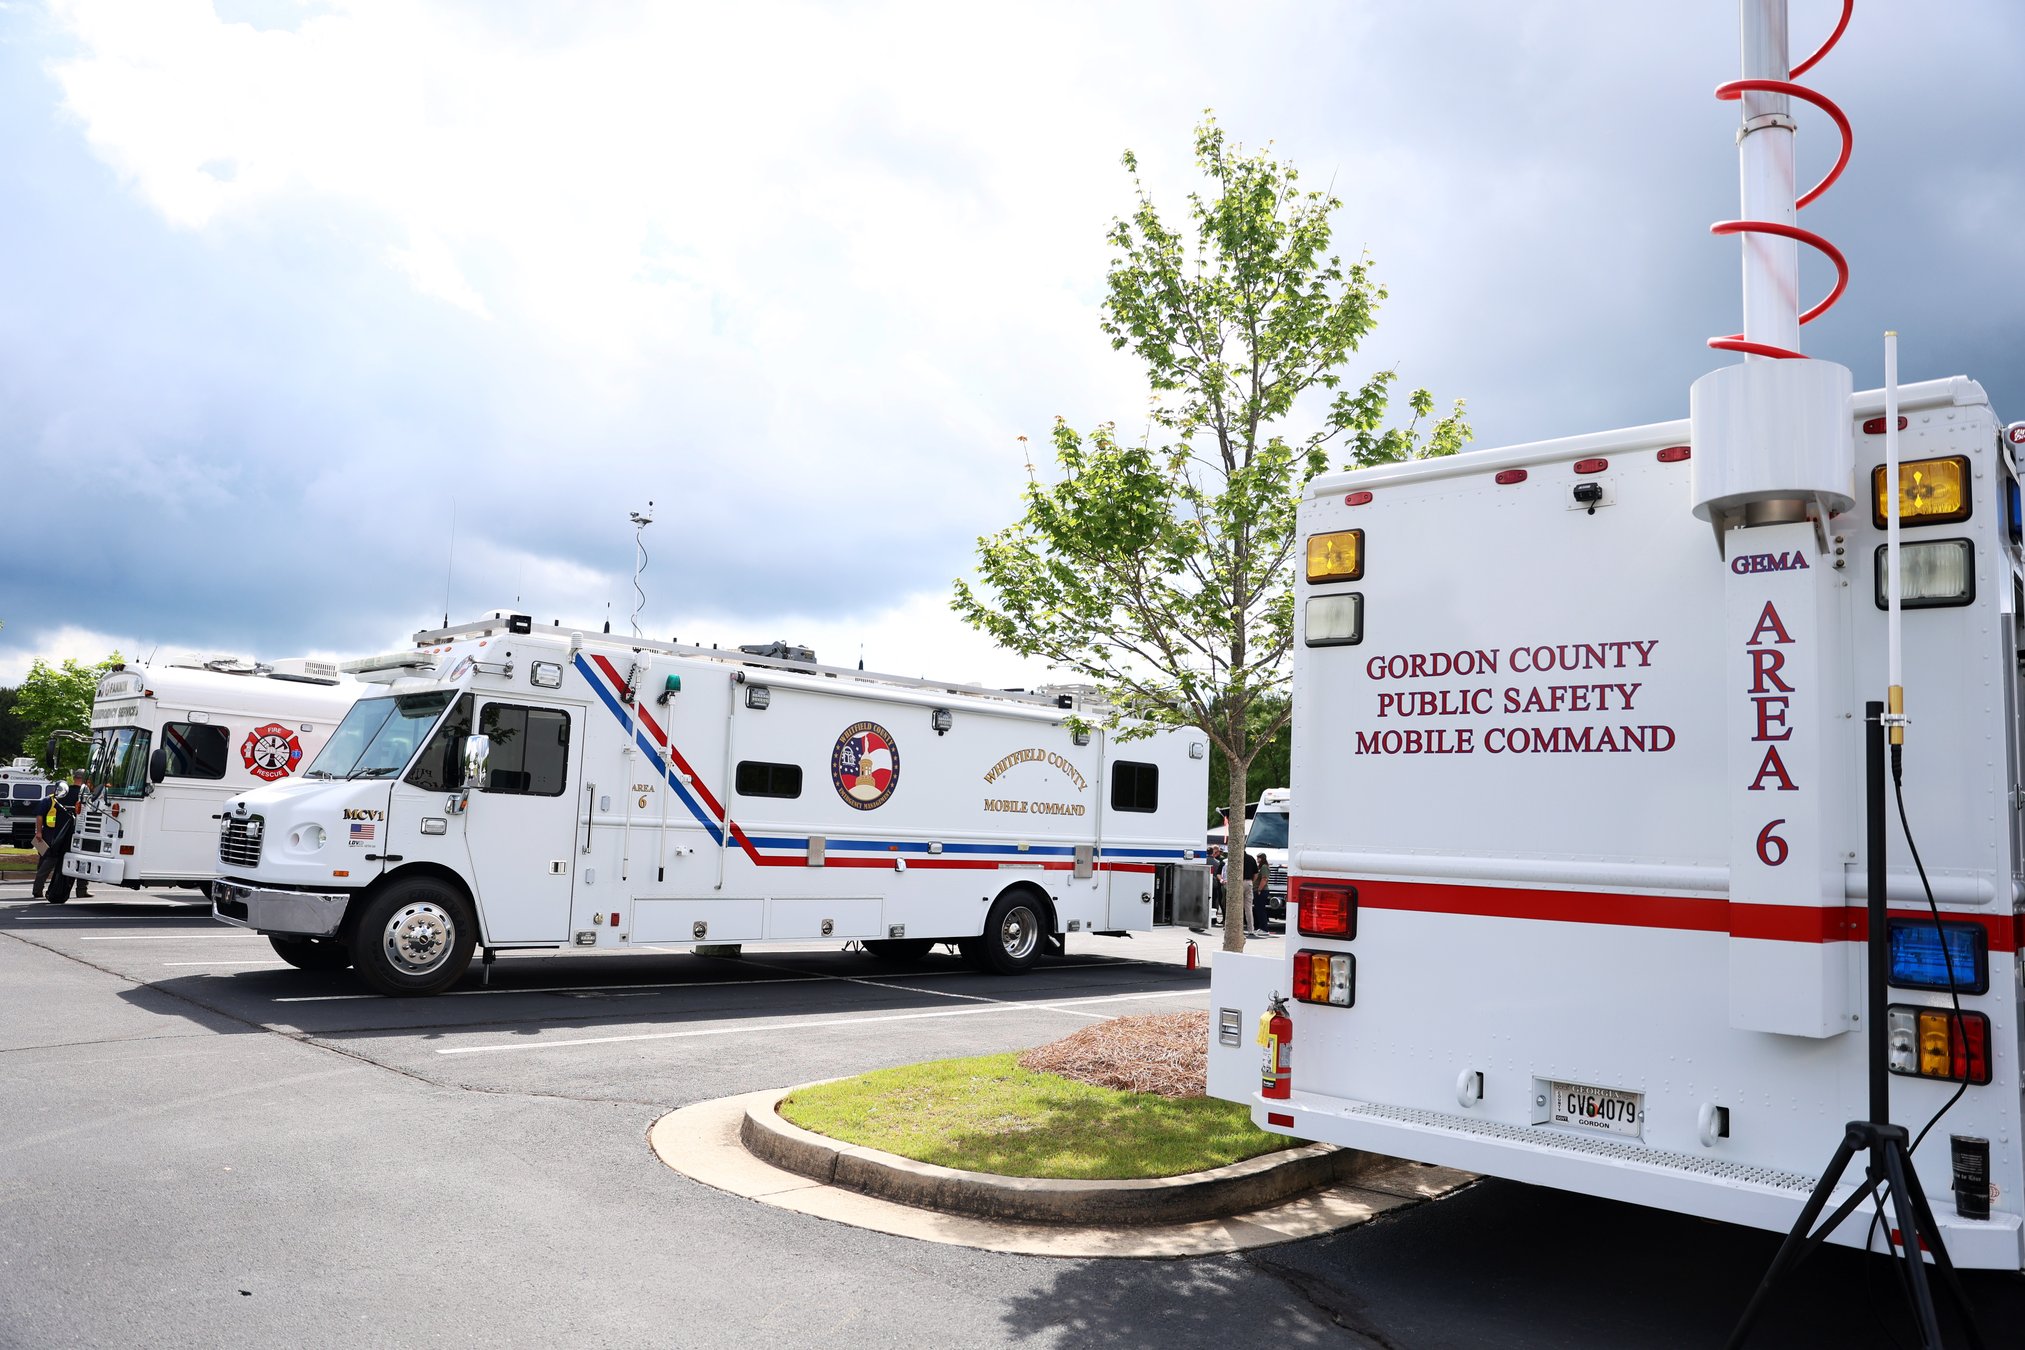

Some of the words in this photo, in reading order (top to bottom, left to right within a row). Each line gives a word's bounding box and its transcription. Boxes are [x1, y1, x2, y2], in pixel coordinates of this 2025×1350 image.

[1731, 551, 1810, 575] GEMA
[1366, 649, 1500, 681] GORDON
[1509, 640, 1660, 673] COUNTY
[1376, 688, 1493, 718] PUBLIC
[1503, 683, 1643, 715] SAFETY
[1746, 600, 1799, 791] AREA
[839, 722, 872, 743] WHITFIELD
[873, 724, 894, 746] COUNTY
[1355, 729, 1475, 755] MOBILE
[1483, 725, 1676, 754] COMMAND
[256, 769, 283, 778] RESCUE
[983, 748, 1046, 784] WHITFIELD
[1047, 752, 1088, 792] COUNTY
[631, 783, 655, 793] AREA
[638, 794, 648, 809] 6
[983, 799, 1028, 814] MOBILE
[1030, 801, 1086, 817] COMMAND
[342, 808, 384, 822] MCV1
[1756, 819, 1788, 866] 6
[1571, 1085, 1621, 1099] GEORGIA
[1567, 1092, 1636, 1124] GV64079
[1578, 1119, 1610, 1129] GORDON
